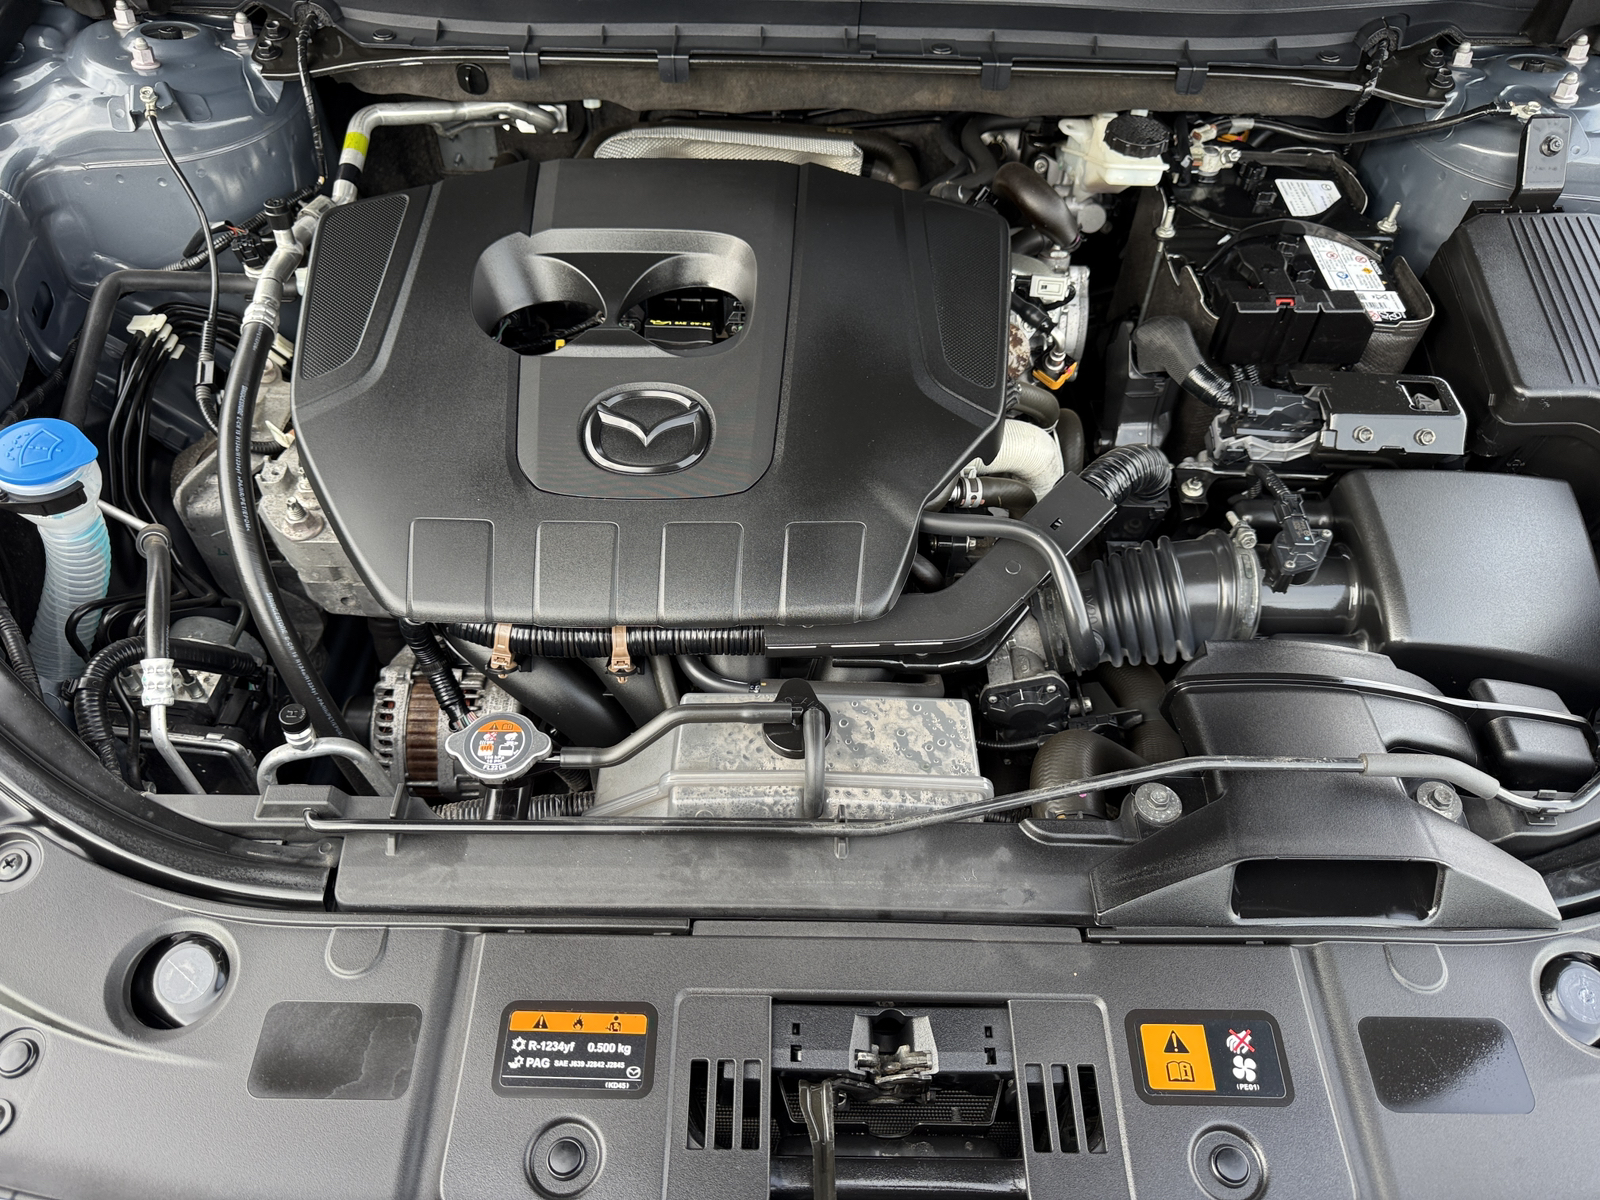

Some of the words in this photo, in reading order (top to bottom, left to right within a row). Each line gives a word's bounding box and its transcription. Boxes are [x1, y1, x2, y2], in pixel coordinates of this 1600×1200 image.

[527, 1040, 576, 1054] R-1234yf
[587, 1042, 616, 1053] 0.500
[617, 1042, 632, 1056] kg
[525, 1057, 551, 1068] PAG
[553, 1059, 568, 1067] SAE
